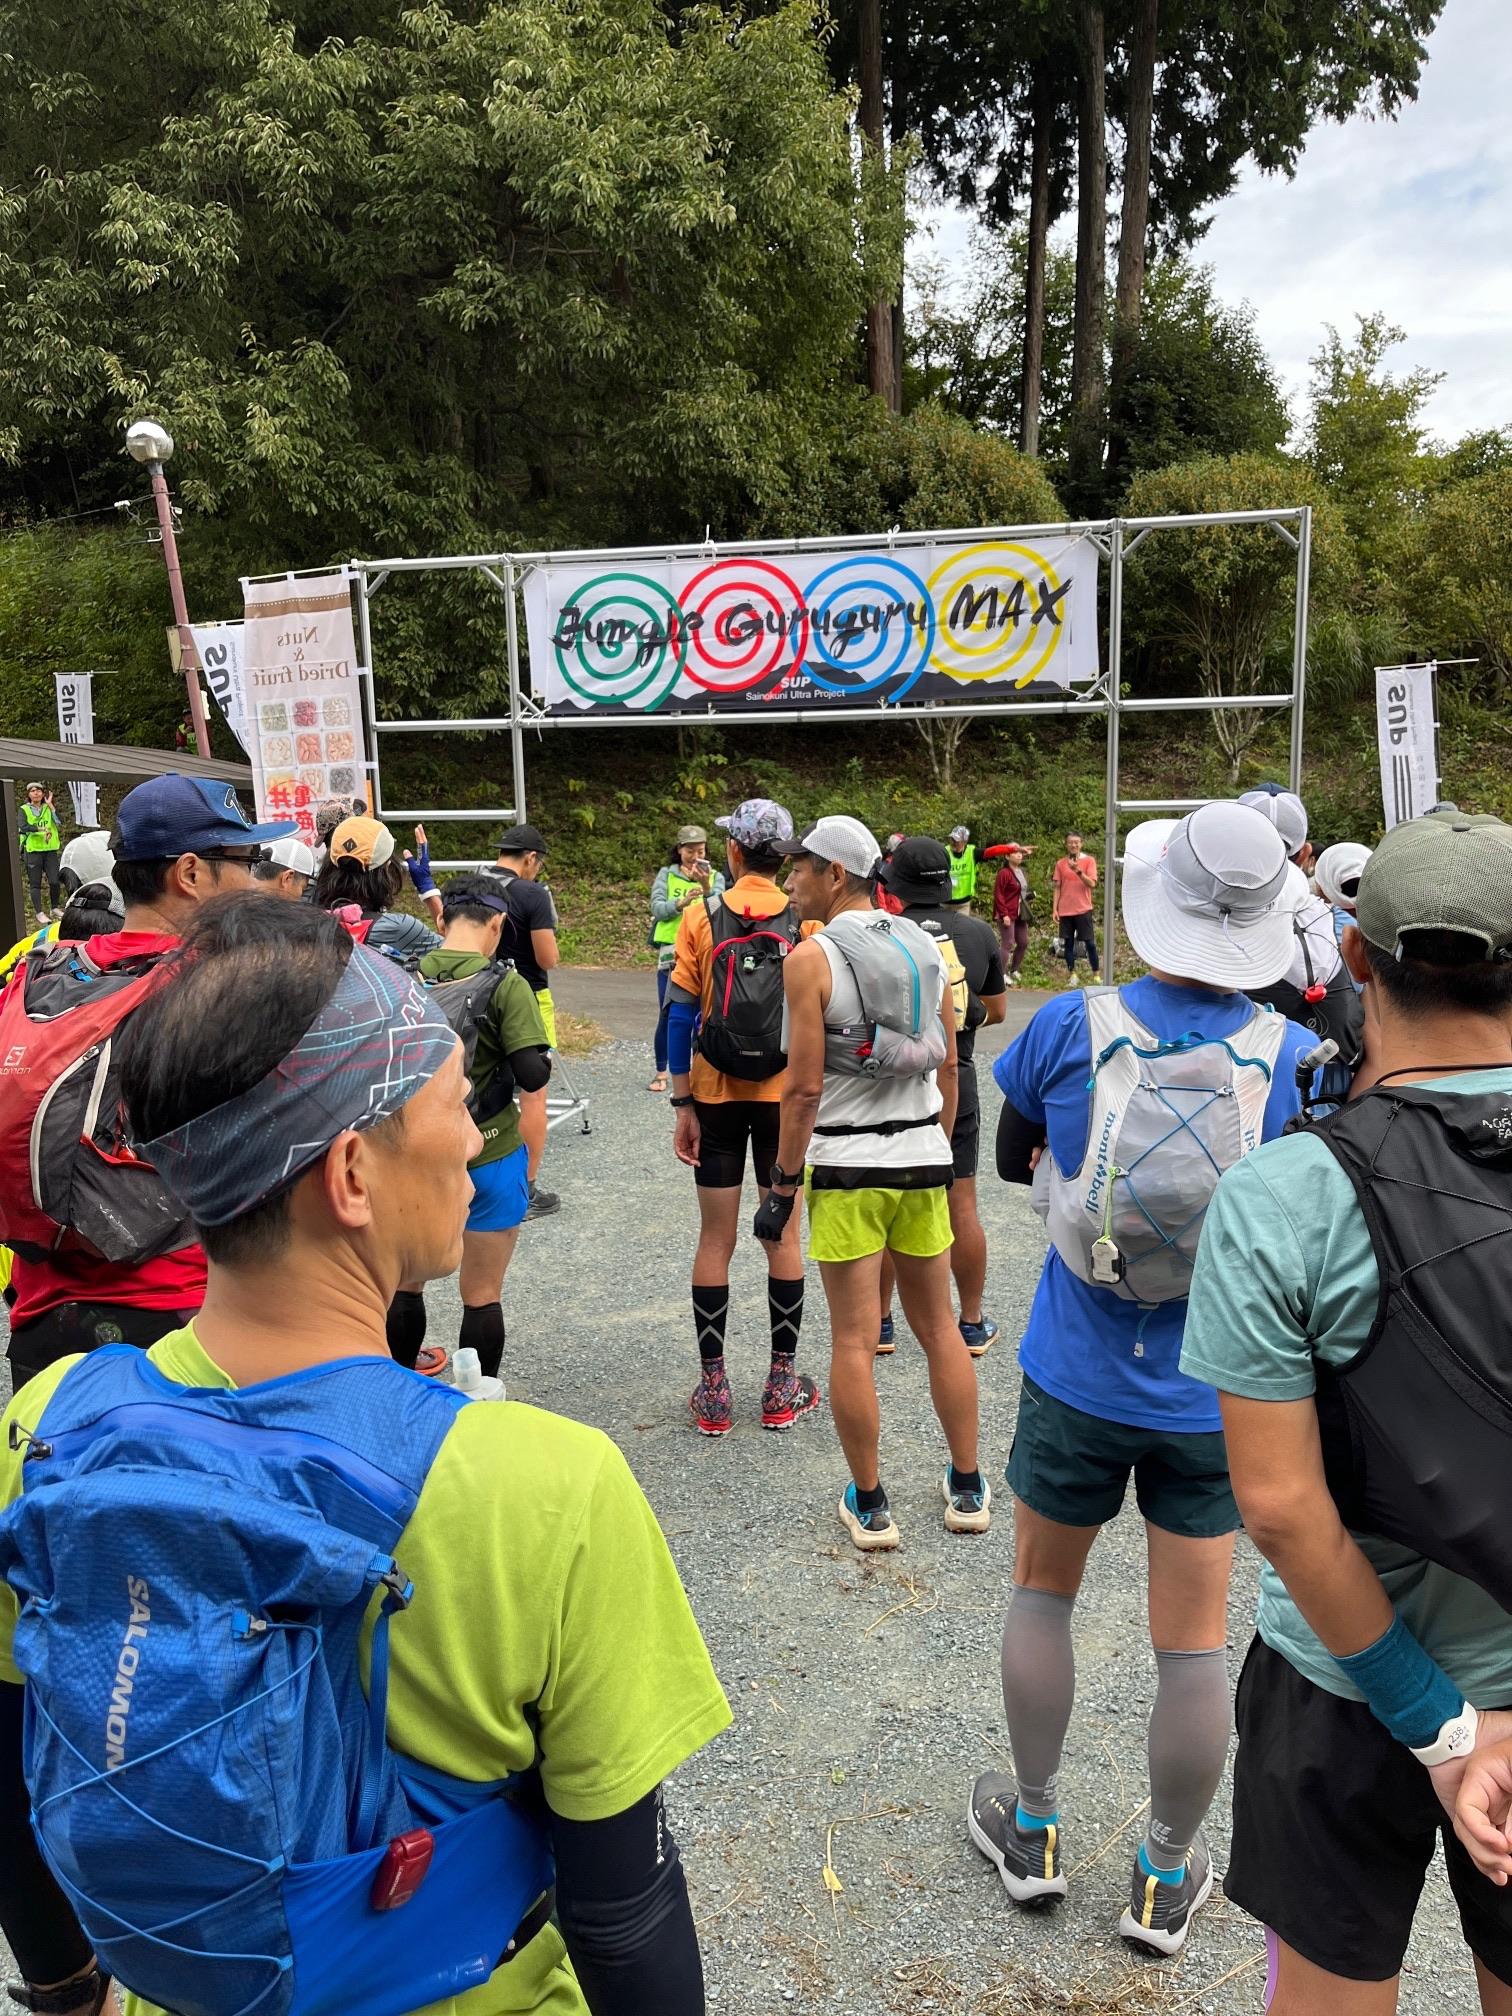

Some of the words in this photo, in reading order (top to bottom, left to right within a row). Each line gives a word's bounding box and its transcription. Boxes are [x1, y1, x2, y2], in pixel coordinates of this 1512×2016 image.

[550, 604, 704, 668] Jungle
[725, 599, 928, 660] Guruguru
[949, 575, 1074, 632] MAX
[745, 691, 788, 701] Sainokuni
[790, 690, 811, 699] Ultra
[814, 689, 846, 699] Project
[780, 677, 811, 688] SUP
[106, 1575, 151, 1775] SALOMON
